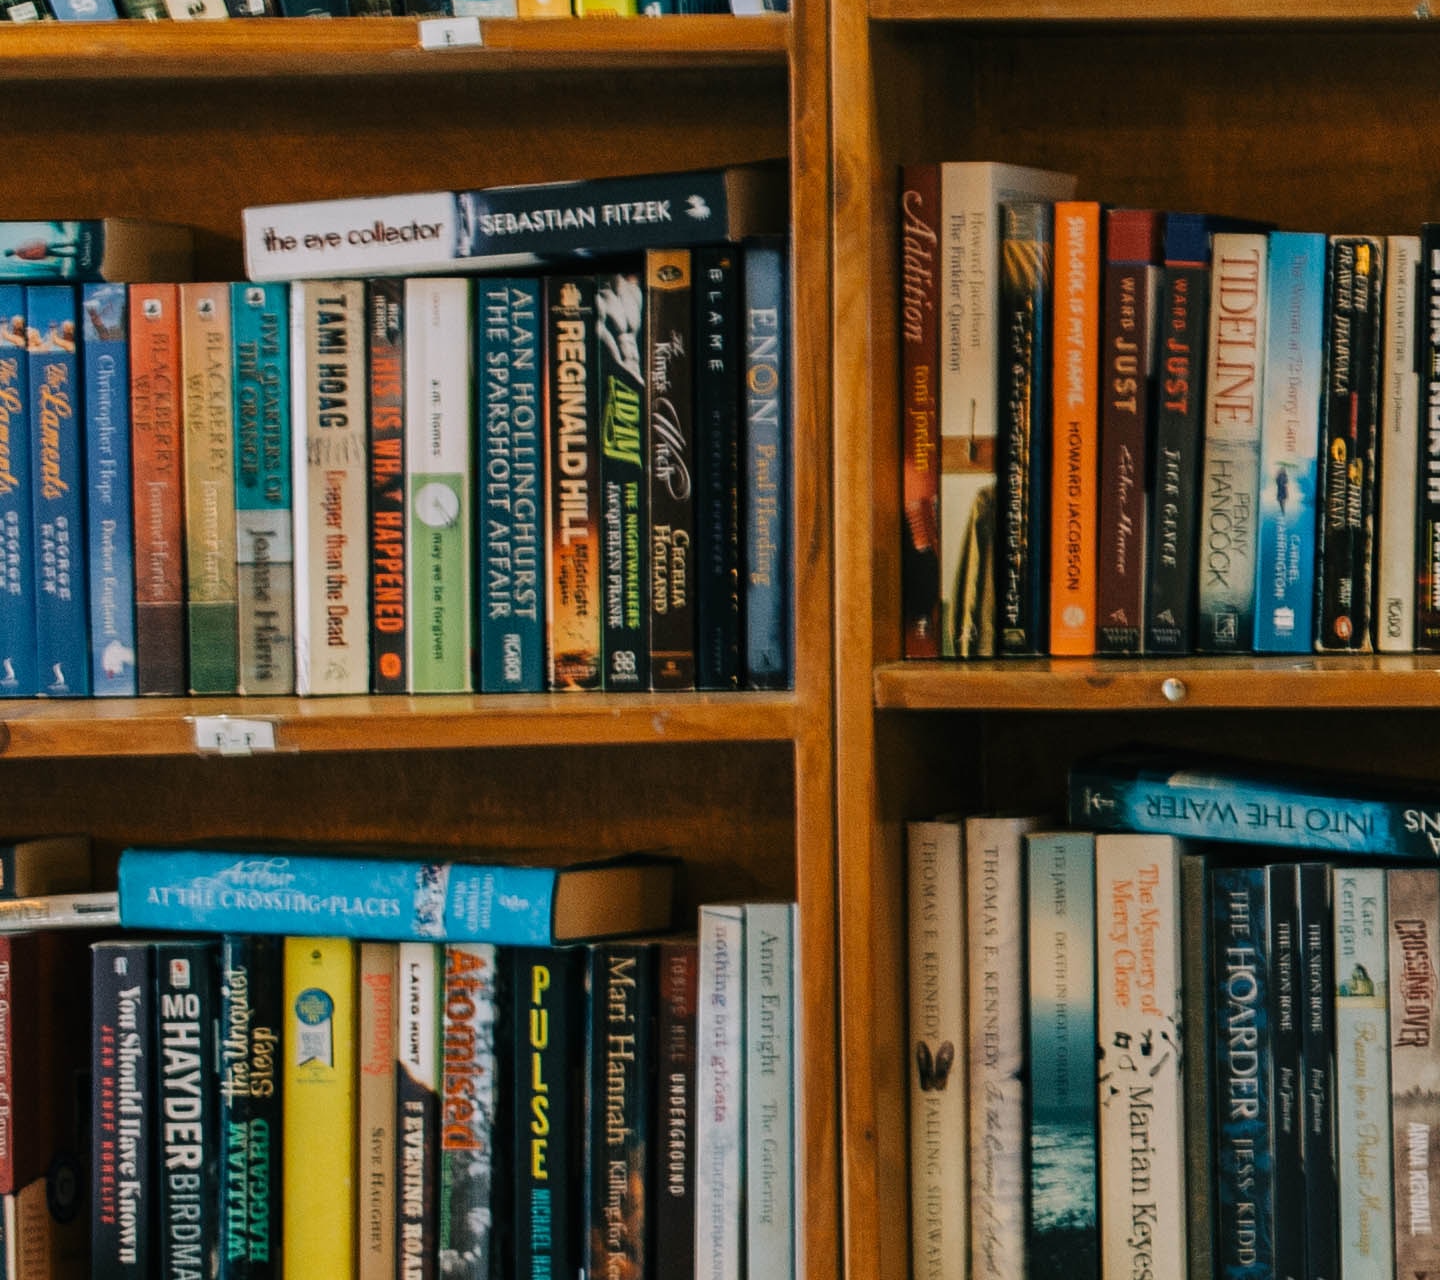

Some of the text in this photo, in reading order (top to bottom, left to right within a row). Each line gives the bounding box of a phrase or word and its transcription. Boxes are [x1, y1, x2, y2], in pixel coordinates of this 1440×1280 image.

[262, 220, 444, 254] the eye collector
[1214, 250, 1259, 425] TIDELINE
[318, 294, 349, 428] TAMI HOAG
[486, 287, 511, 620] THE SPARSHOLT AFFAIR
[513, 288, 537, 621] ALAN HOLLINGHURST
[557, 320, 587, 544] REGINALD HILL
[165, 1022, 202, 1170] HAYDER
[443, 948, 486, 1151] Atomised
[1225, 891, 1259, 1119] THE HOARDER
[119, 986, 142, 1264] You Should Have Known
[1127, 1085, 1155, 1198] Marian
